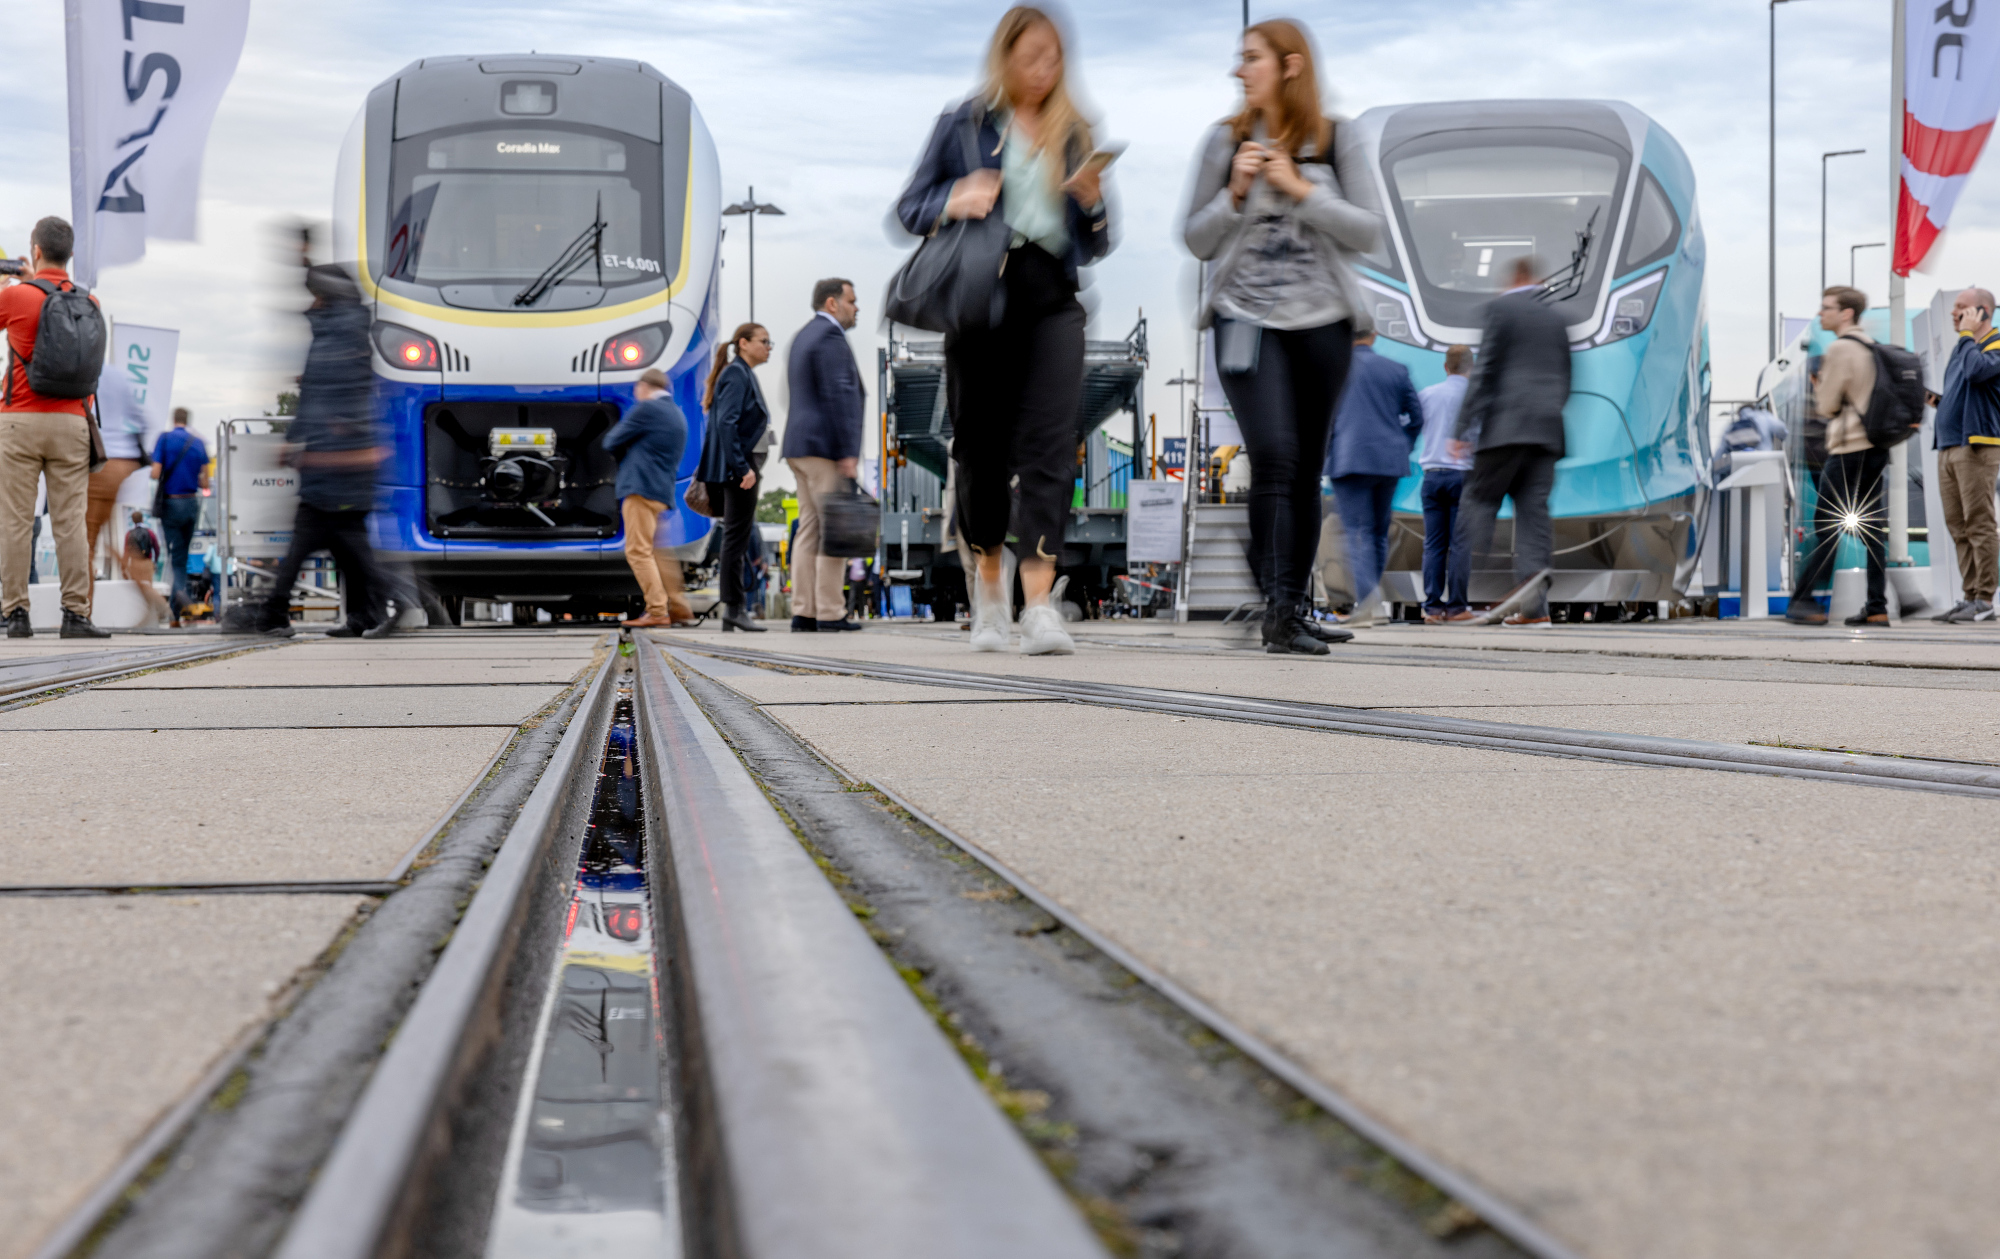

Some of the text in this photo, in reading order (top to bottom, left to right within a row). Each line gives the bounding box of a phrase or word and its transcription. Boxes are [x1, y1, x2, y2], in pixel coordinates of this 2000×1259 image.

[497, 142, 561, 153] Coradia Max
[603, 254, 661, 274] ET-6.001
[252, 478, 294, 488] ALSTOM
